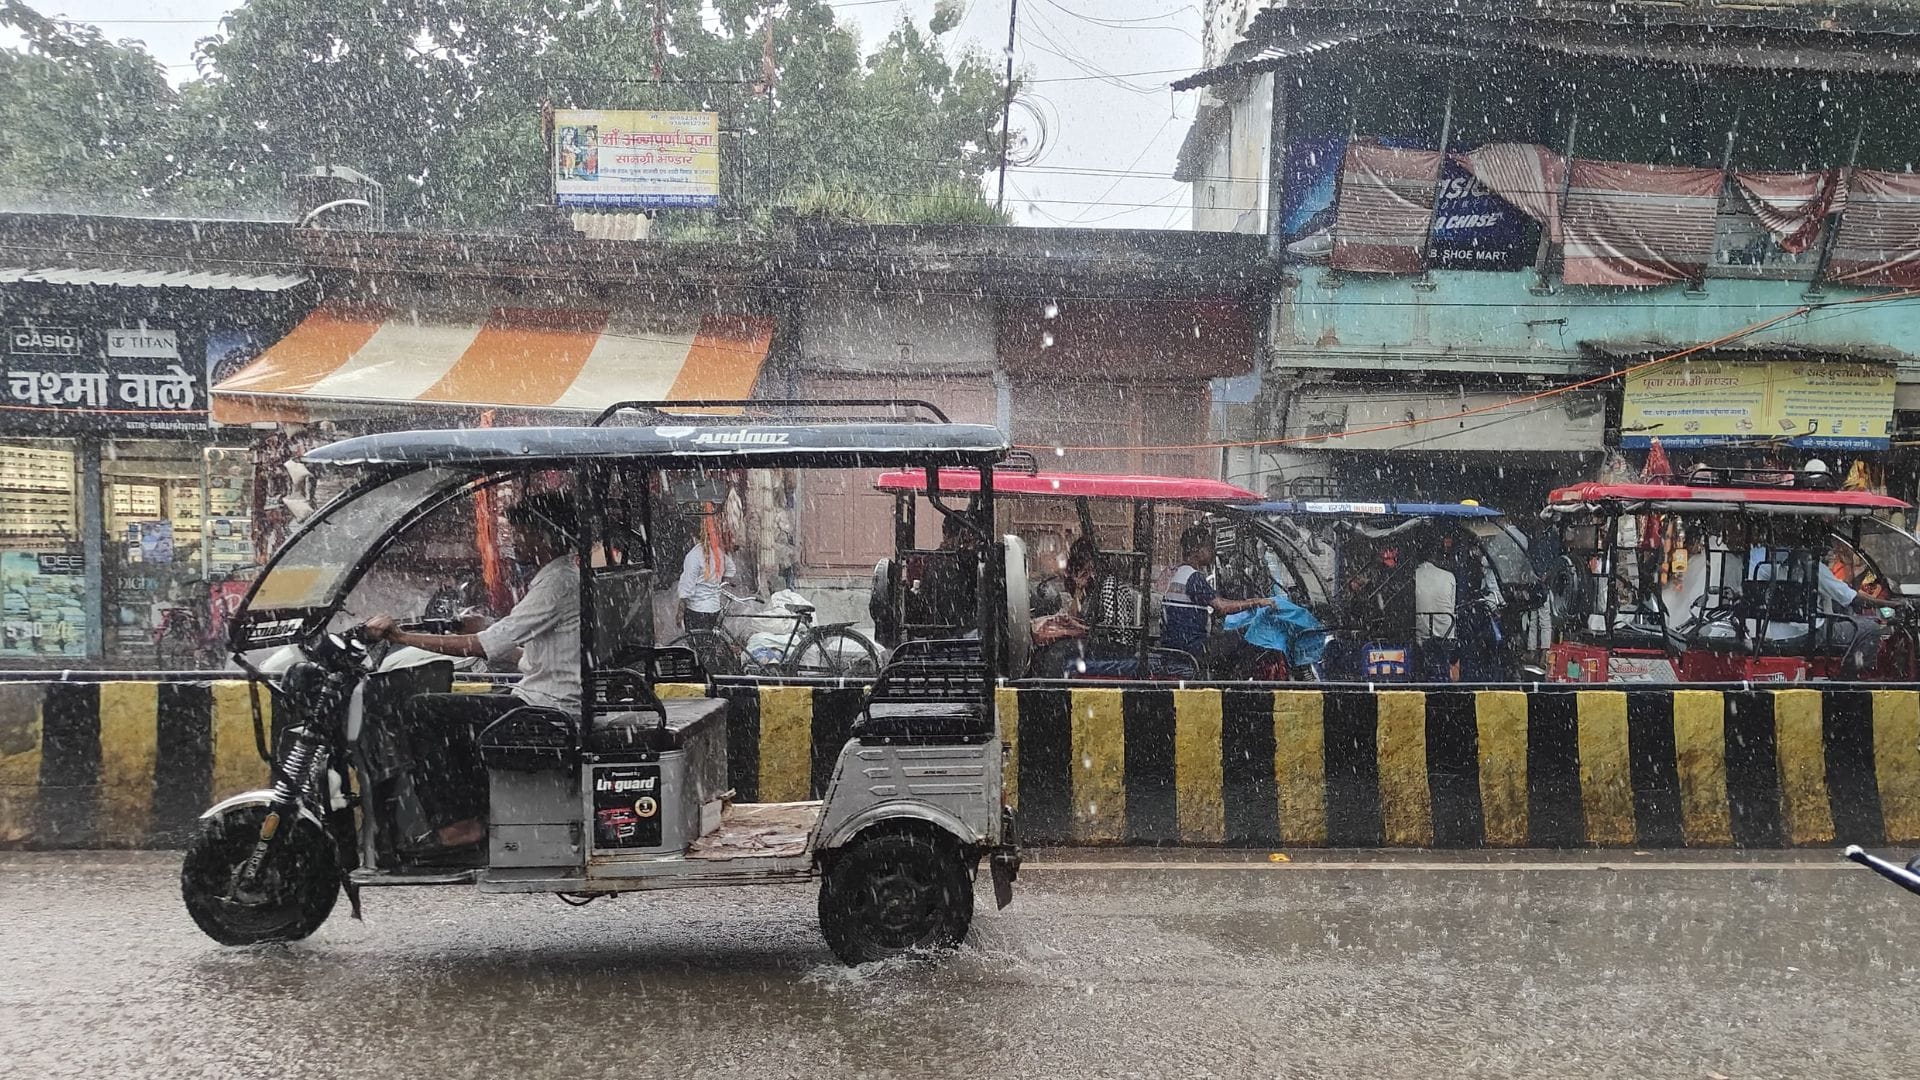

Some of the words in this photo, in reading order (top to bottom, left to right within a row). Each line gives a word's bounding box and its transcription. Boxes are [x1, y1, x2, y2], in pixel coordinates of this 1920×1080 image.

[684, 134, 713, 154] पूजा
[1444, 250, 1473, 259] SHOE
[1476, 251, 1507, 260] MART
[15, 334, 75, 348] CASIO
[129, 336, 174, 349] TITAN
[8, 370, 109, 406] चश्मा
[117, 365, 196, 409] वाले
